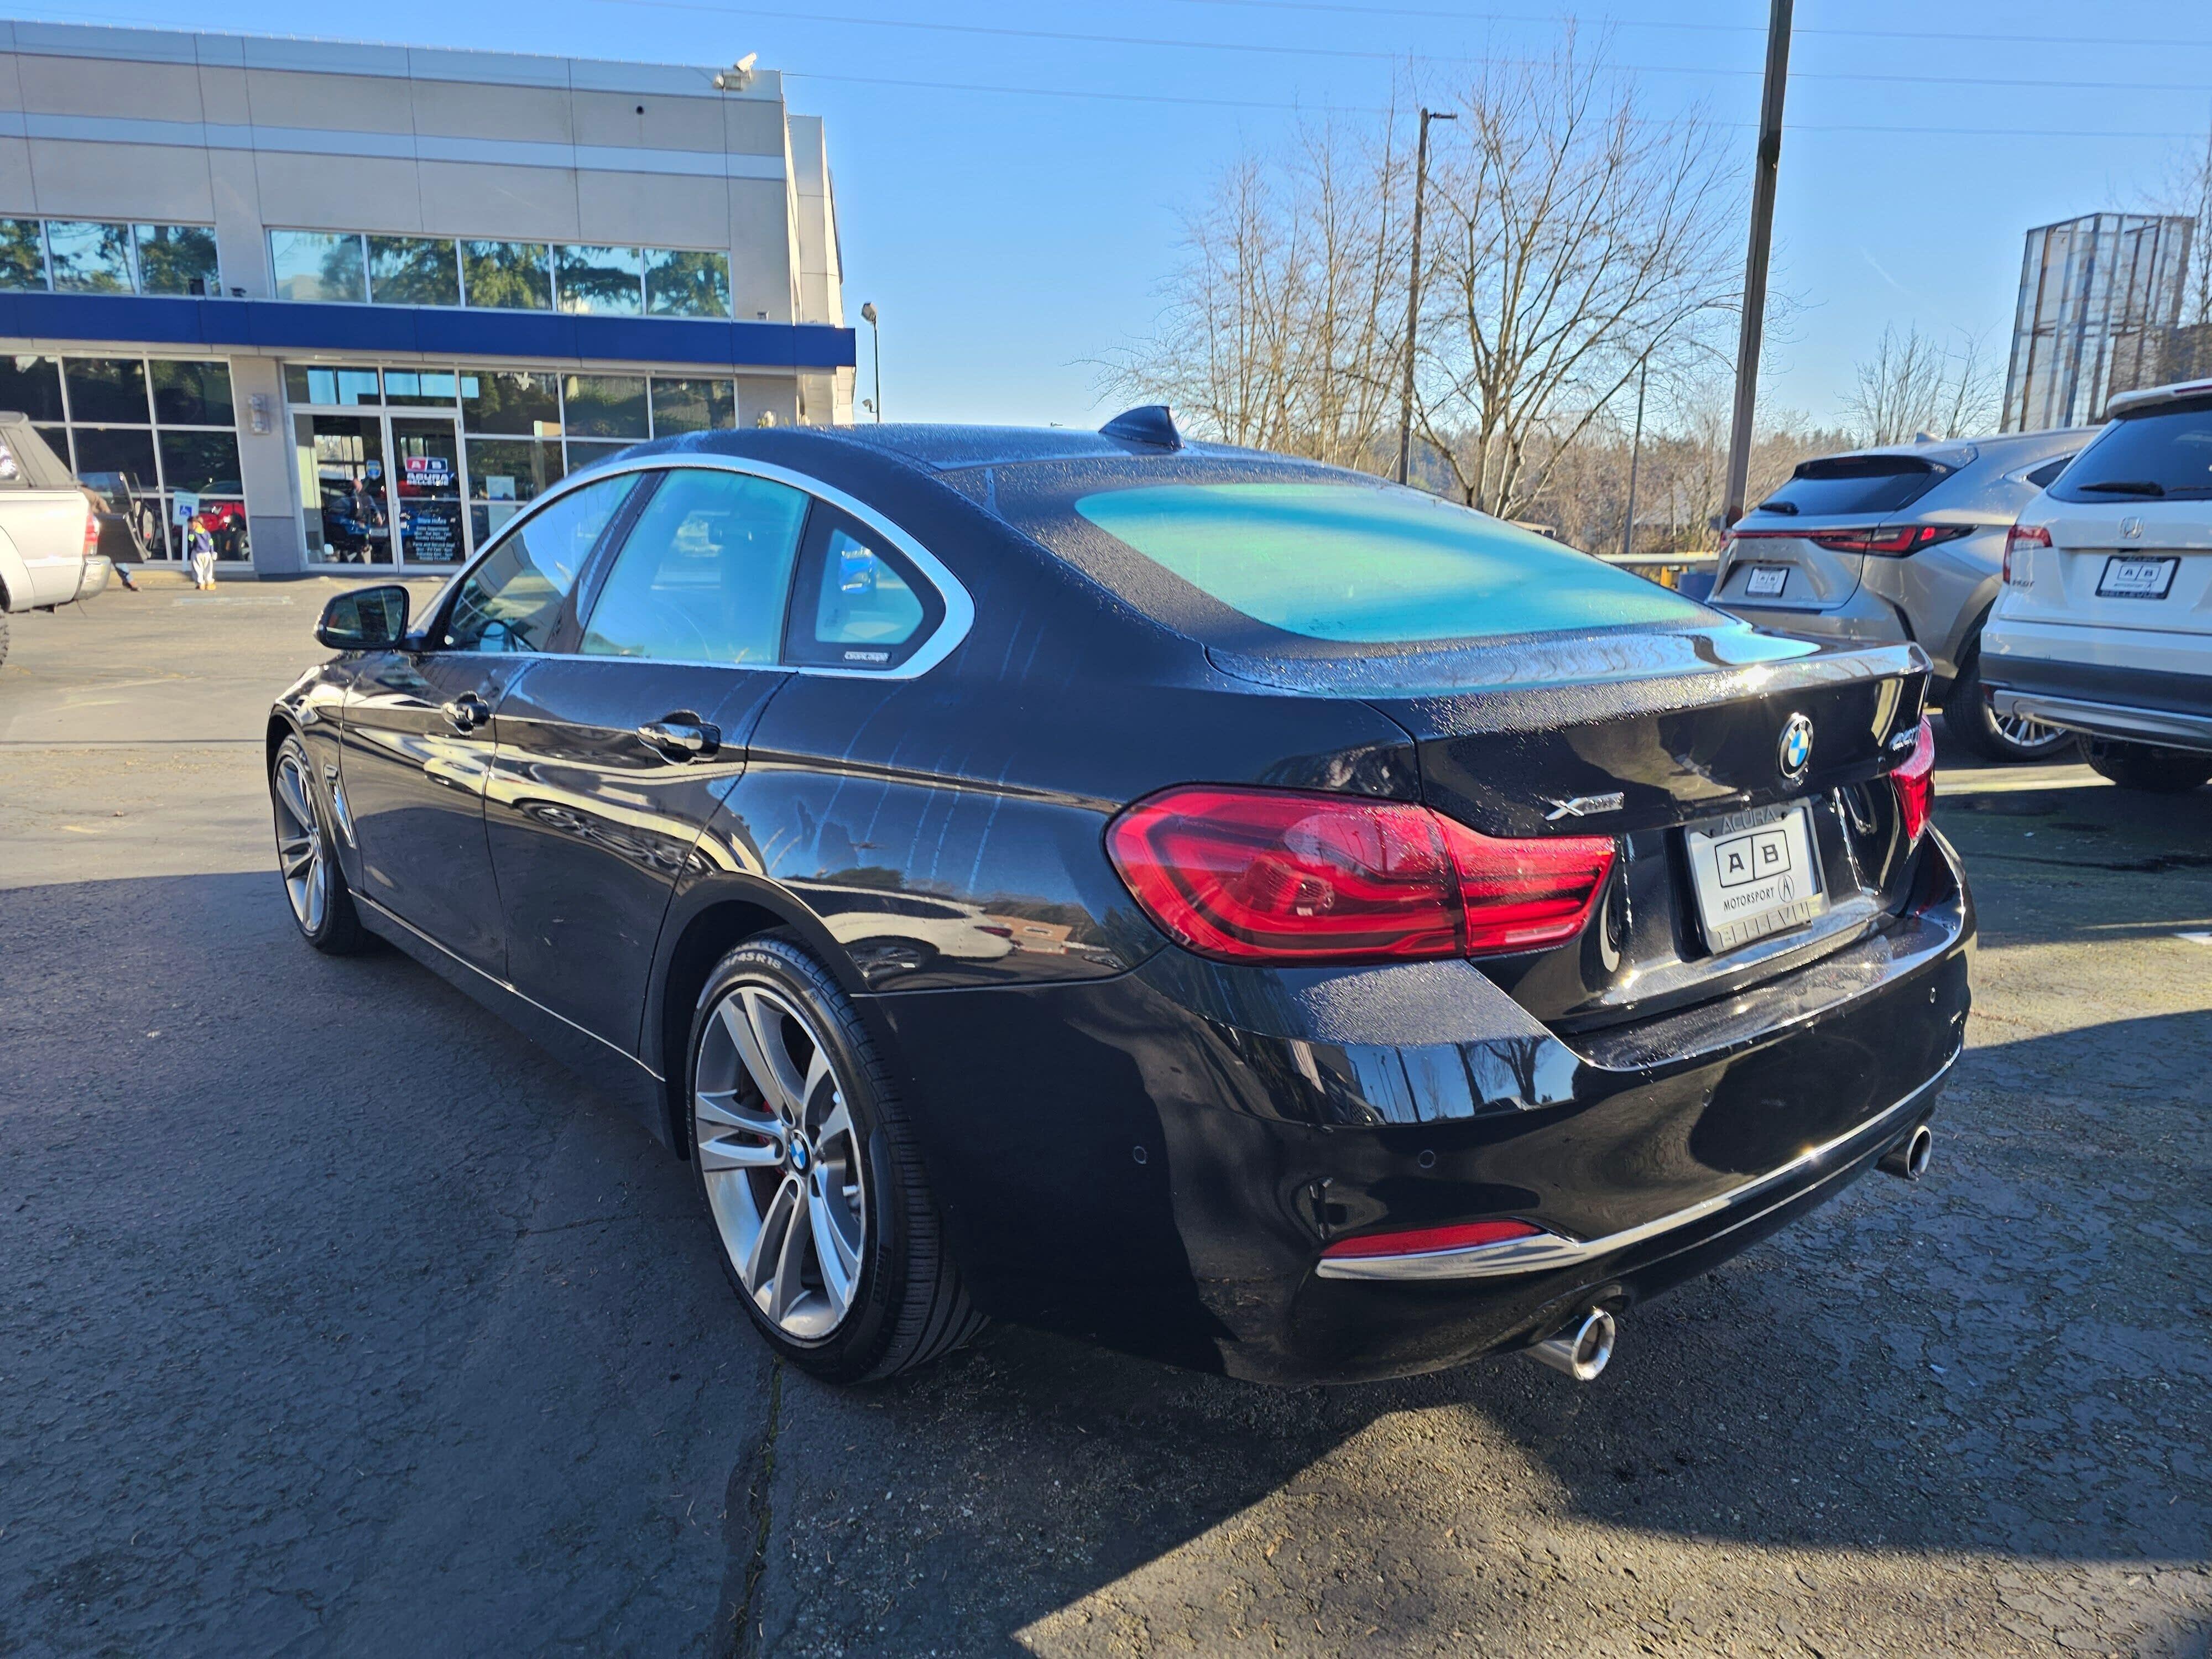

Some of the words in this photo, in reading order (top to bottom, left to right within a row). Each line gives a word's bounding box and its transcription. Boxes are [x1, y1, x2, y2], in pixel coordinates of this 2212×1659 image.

[411, 460, 421, 469] A
[1721, 805, 1777, 835] ACURA
[1728, 853, 1745, 874] A
[1761, 843, 1780, 864] B
[1723, 886, 1775, 912] MOTORSPORT
